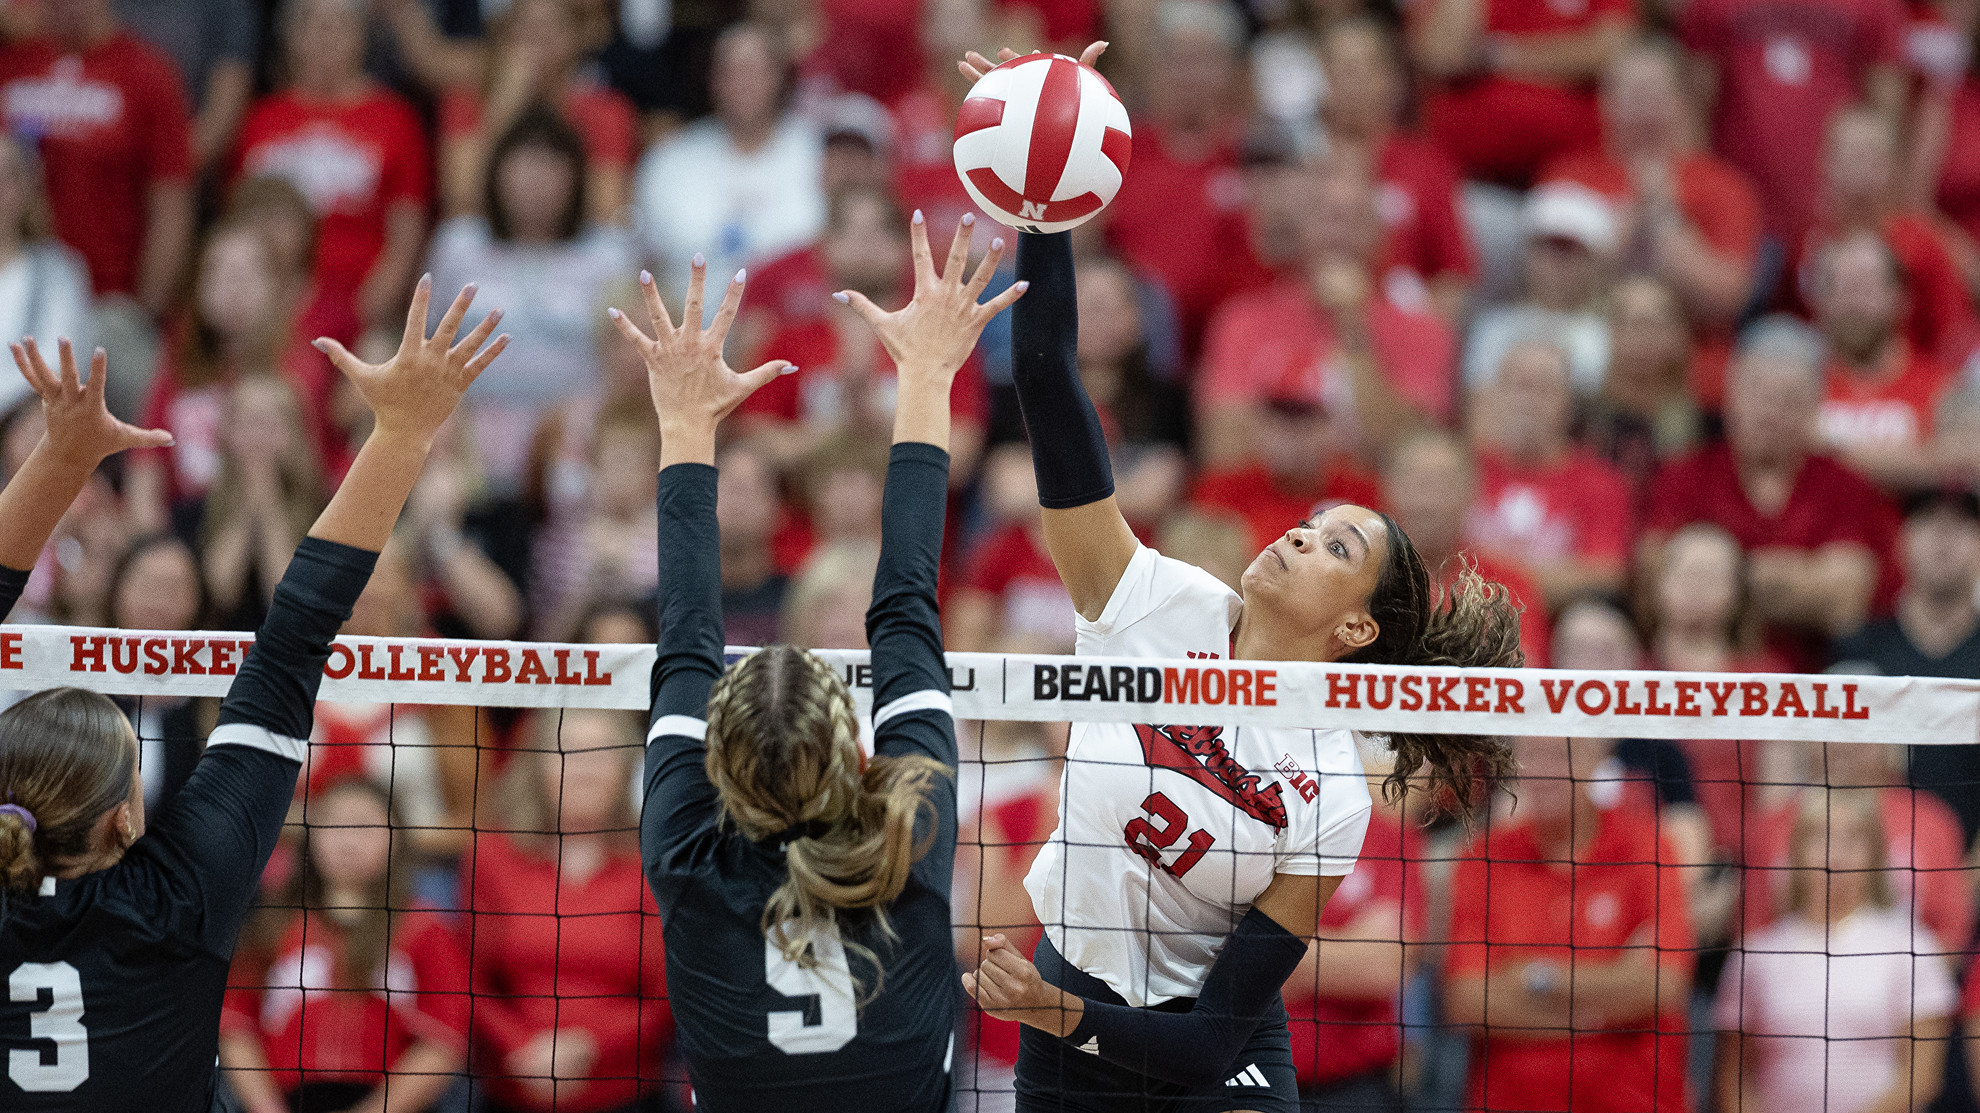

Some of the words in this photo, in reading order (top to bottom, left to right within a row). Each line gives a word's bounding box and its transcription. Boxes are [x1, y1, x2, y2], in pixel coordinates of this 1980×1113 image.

[1018, 199, 1048, 220] N
[323, 642, 613, 686] OLLEYBALL
[1033, 664, 1278, 707] BEARDMORE
[1325, 672, 1526, 714] HUSKER
[1539, 679, 1870, 720] VOLLEYBALL
[1123, 790, 1216, 879] 21
[764, 913, 858, 1056] 9
[8, 961, 90, 1092] 3
